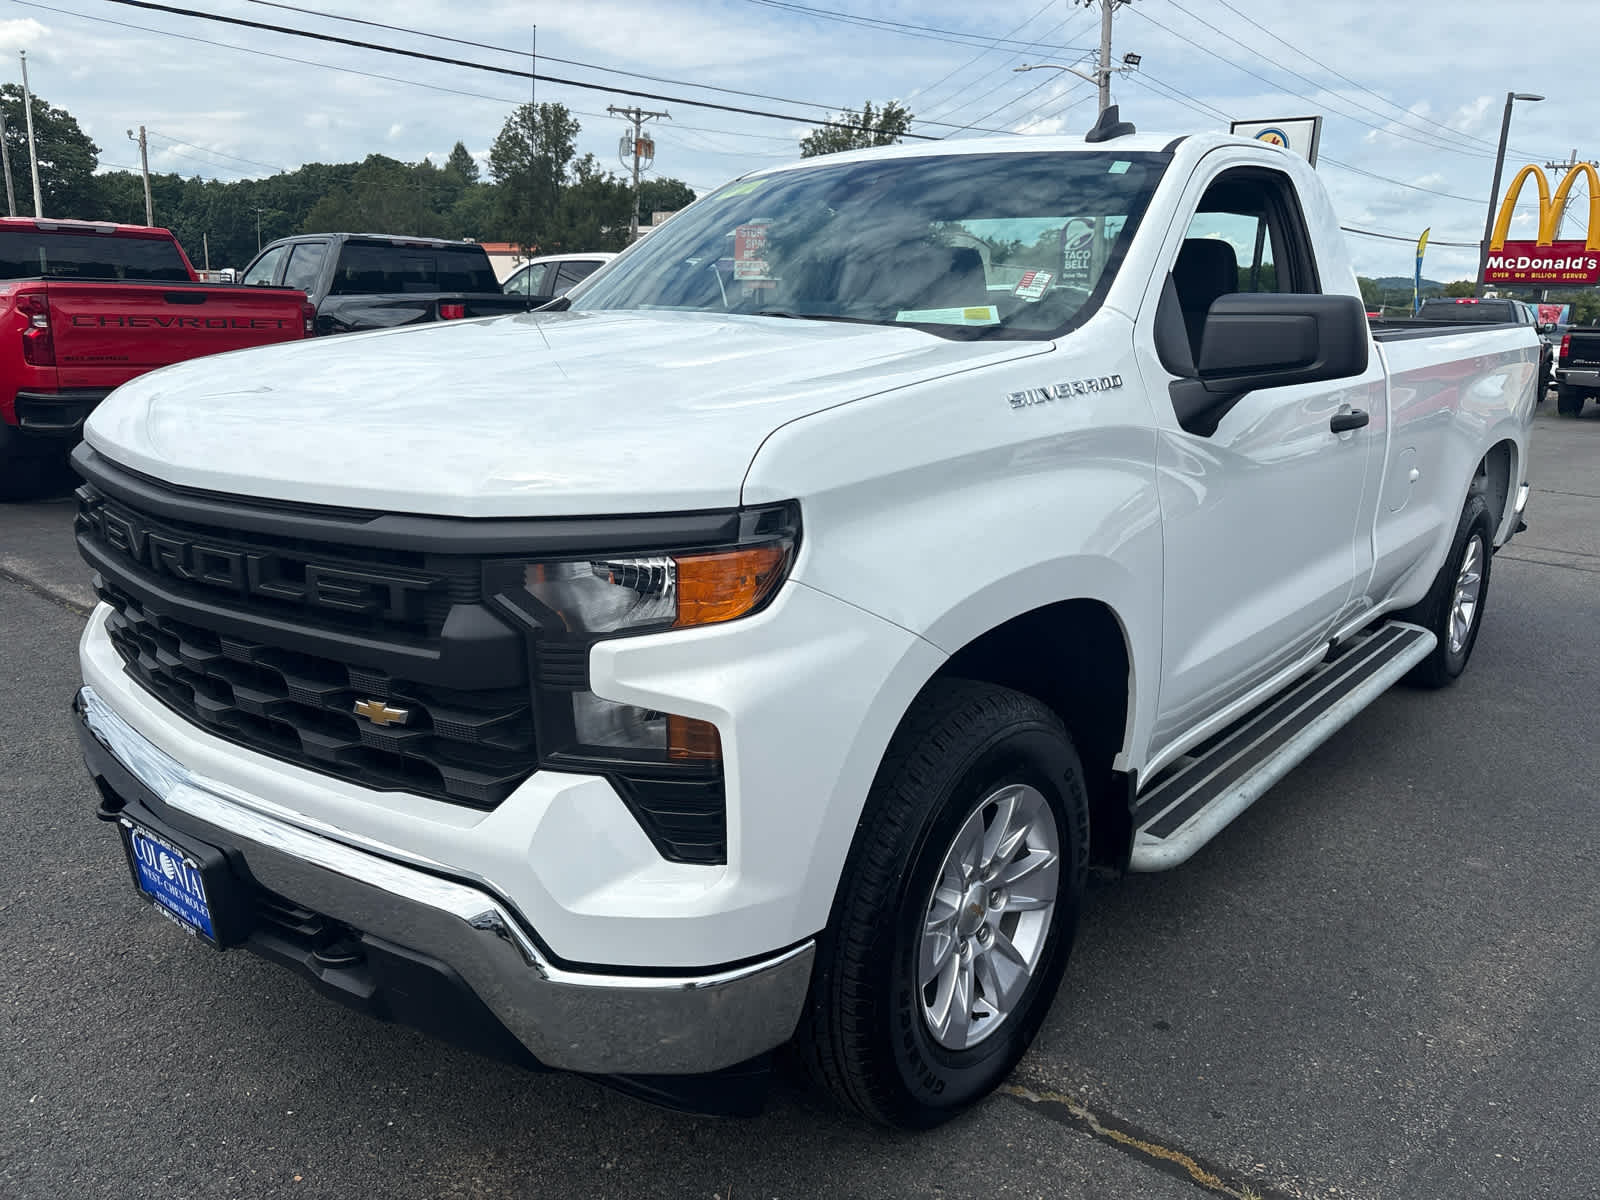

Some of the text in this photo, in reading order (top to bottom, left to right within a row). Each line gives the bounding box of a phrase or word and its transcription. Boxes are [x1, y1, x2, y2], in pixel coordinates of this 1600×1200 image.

[1064, 250, 1091, 260] TACO
[1064, 260, 1089, 270] BELL
[1486, 256, 1598, 270] McDonald's
[72, 315, 289, 329] CHEVROLET
[1007, 375, 1123, 408] SILVERADO
